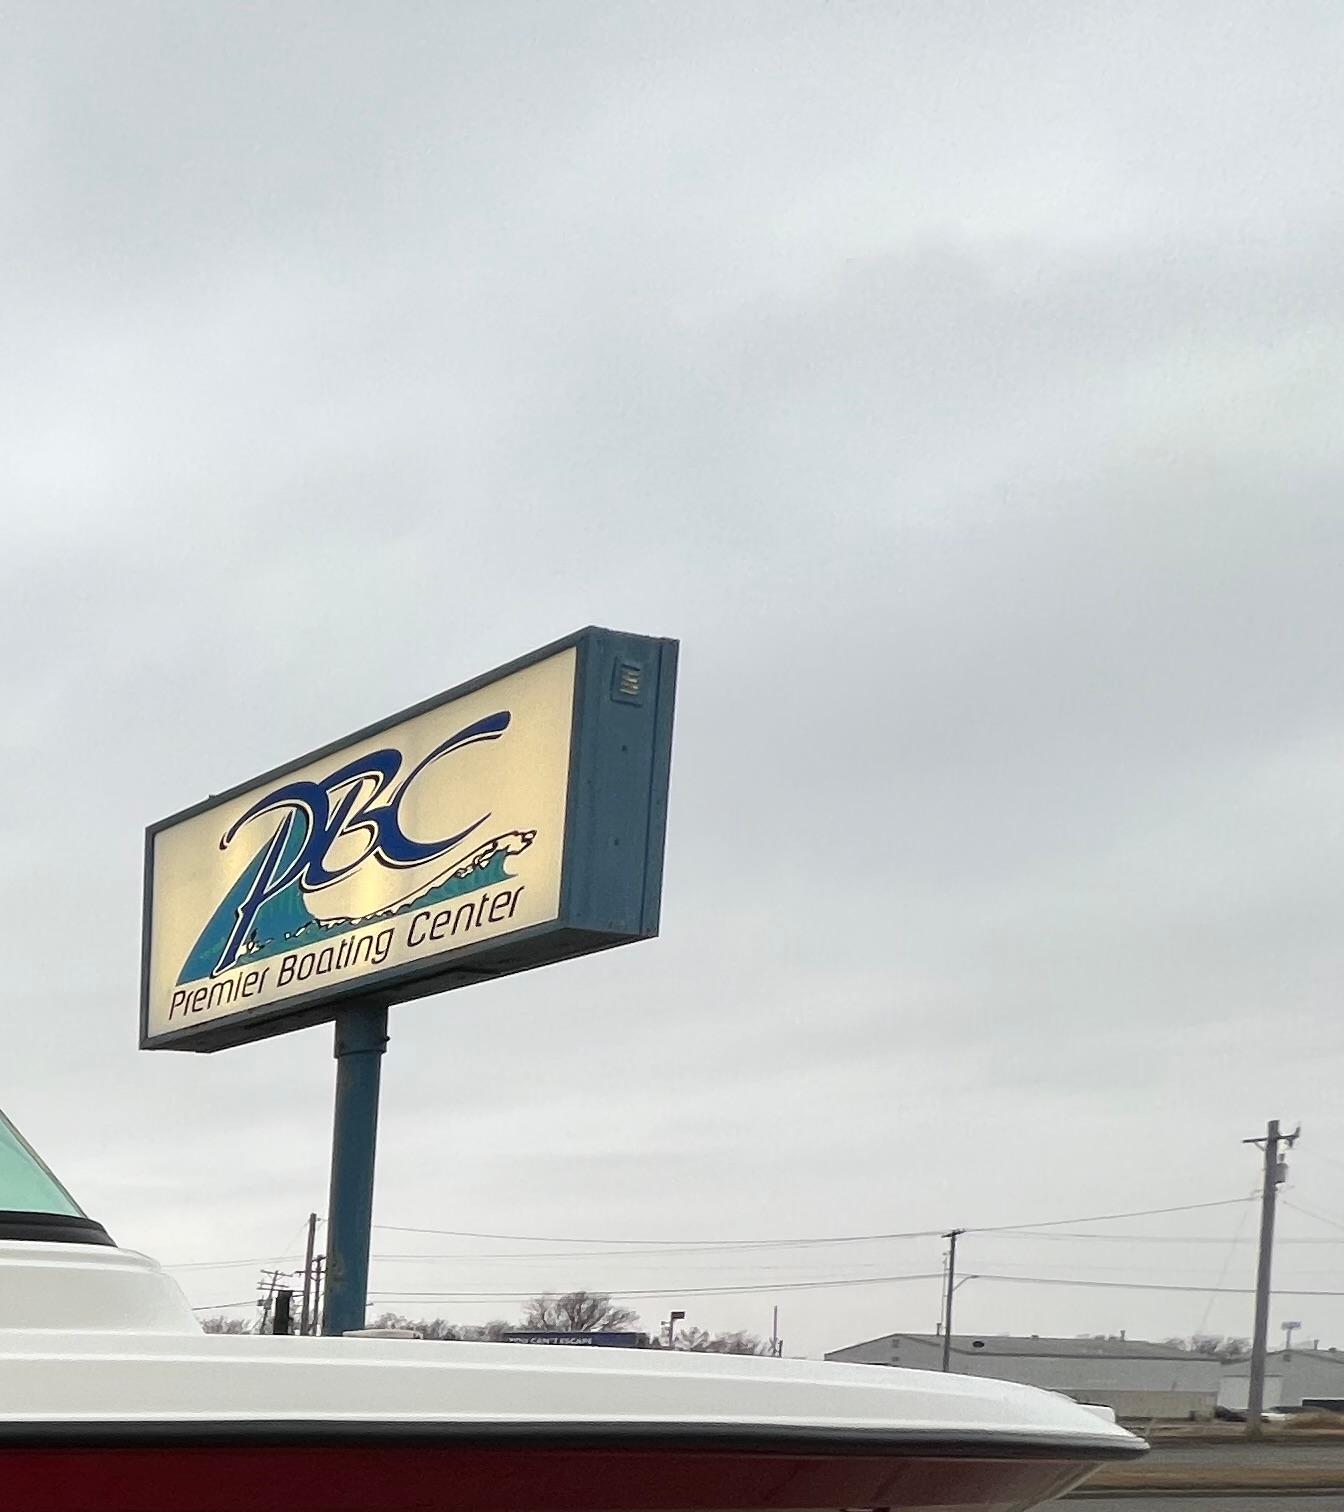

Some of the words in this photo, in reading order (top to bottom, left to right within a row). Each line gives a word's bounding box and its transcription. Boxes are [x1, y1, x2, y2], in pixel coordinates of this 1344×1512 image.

[210, 709, 511, 979] PBC
[168, 968, 269, 1020] Premier
[276, 927, 395, 988] Boating
[407, 887, 525, 948] Center
